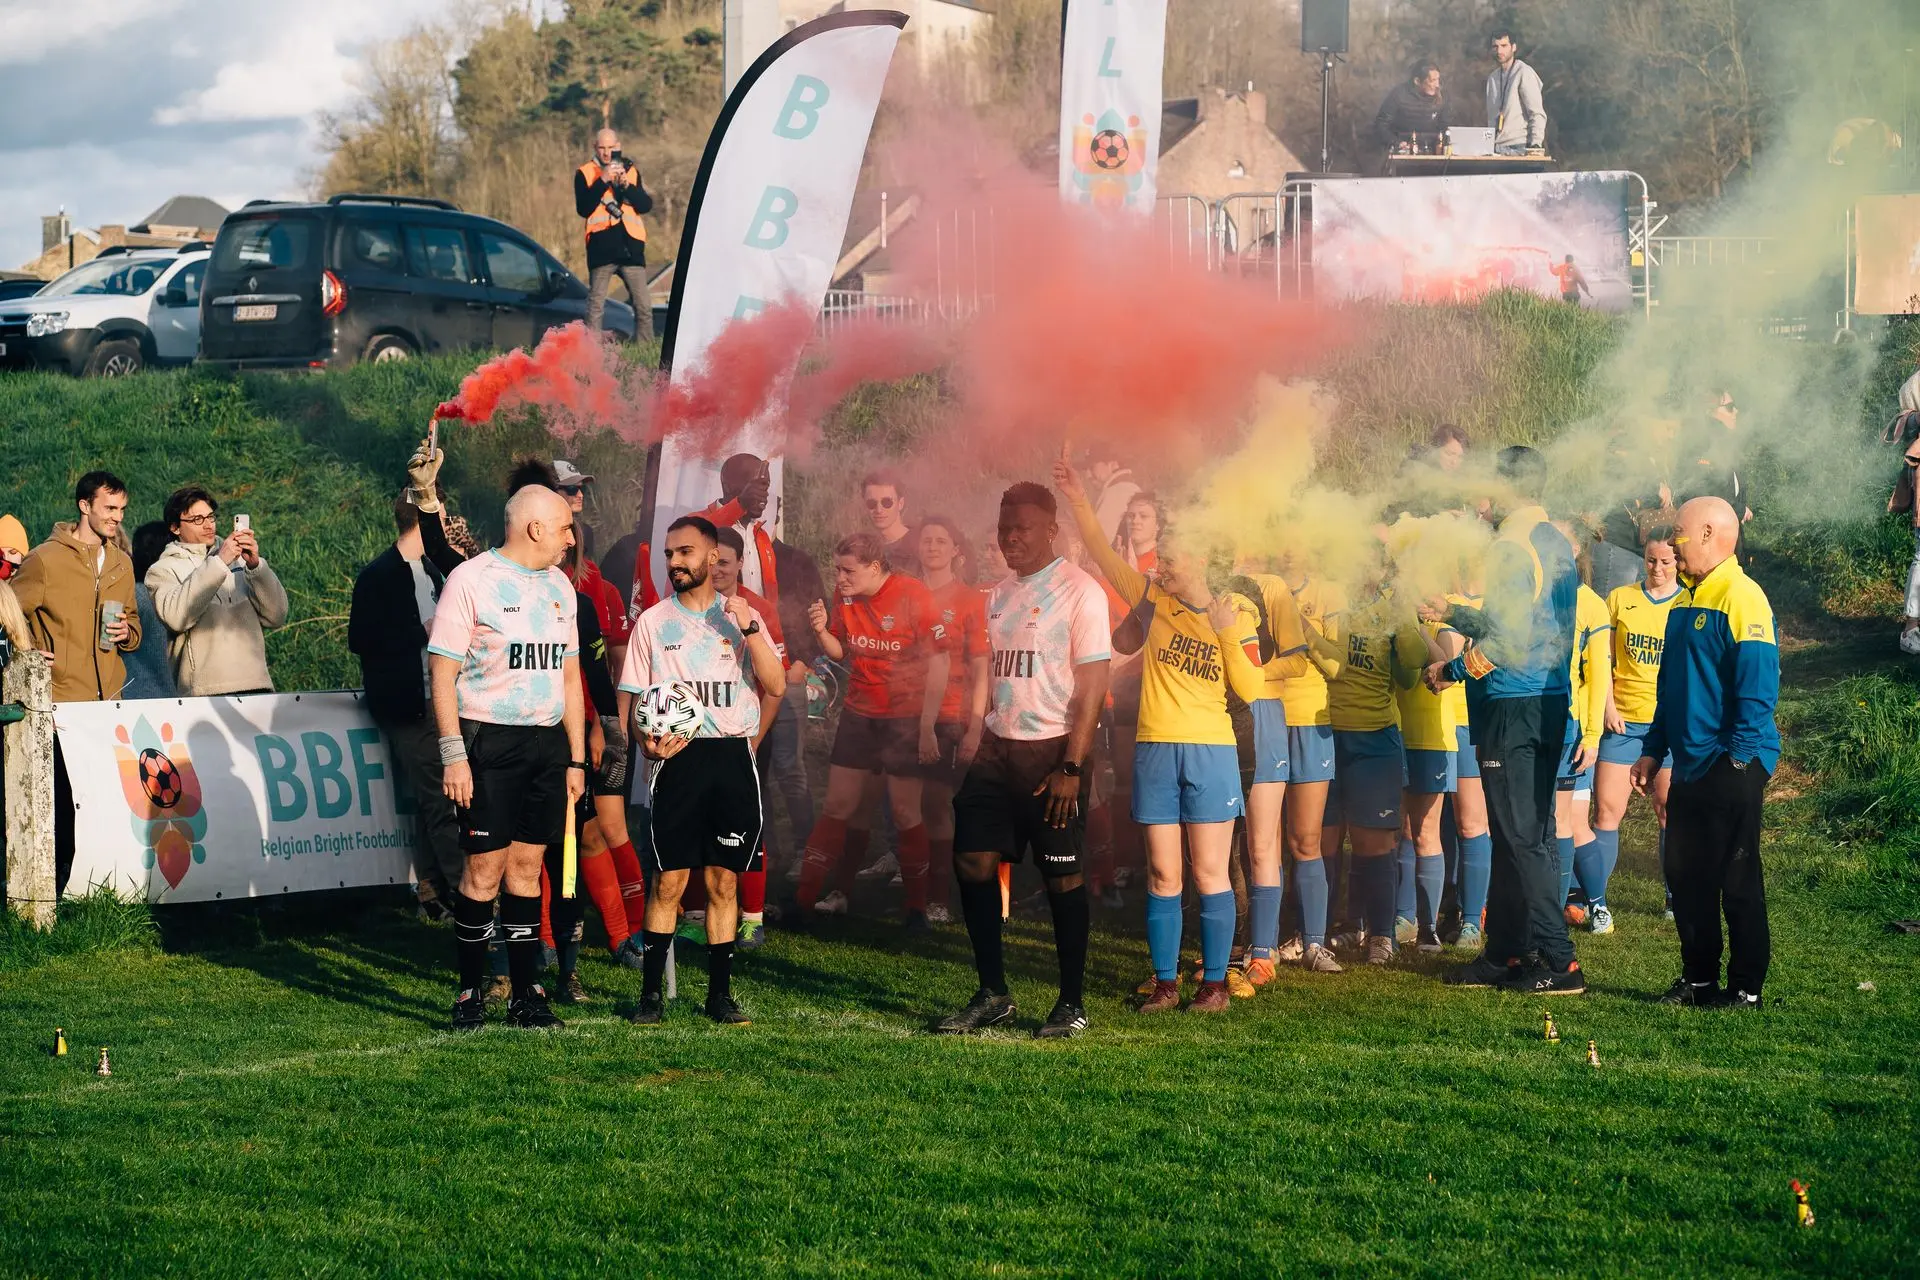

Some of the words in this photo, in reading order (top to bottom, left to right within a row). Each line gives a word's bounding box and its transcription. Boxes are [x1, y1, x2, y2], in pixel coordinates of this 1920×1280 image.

[664, 644, 682, 652] NOLT
[847, 633, 901, 652] LOSING
[1168, 632, 1219, 663] BIERE
[992, 649, 1036, 679] AVET
[1157, 647, 1182, 667] DES
[1179, 656, 1222, 683] AMIS
[683, 681, 732, 708] VET
[260, 836, 313, 861] Belgian
[314, 831, 354, 857] Bright
[355, 828, 401, 850] Football
